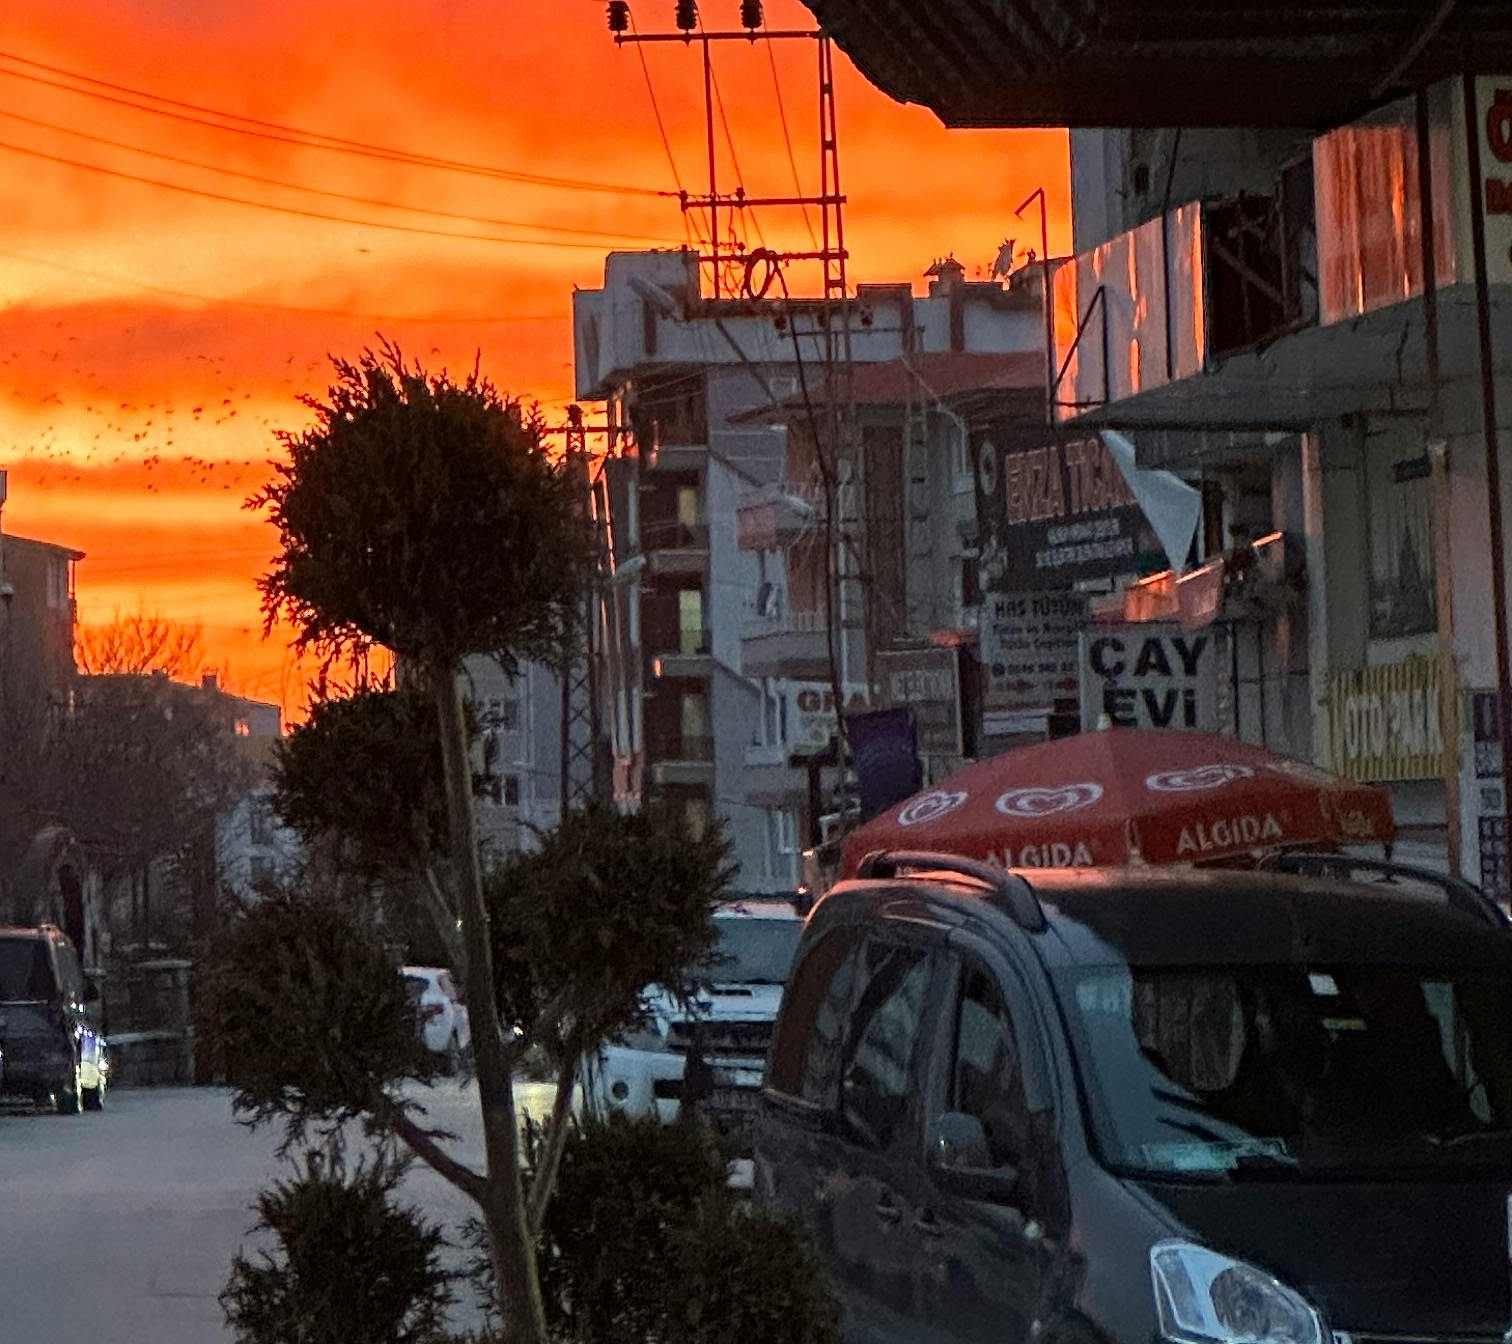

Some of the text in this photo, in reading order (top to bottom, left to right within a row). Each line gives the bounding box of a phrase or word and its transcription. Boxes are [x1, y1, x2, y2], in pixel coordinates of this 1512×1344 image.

[1090, 636, 1209, 687] ÇAY
[1345, 693, 1384, 760] OTO
[1176, 814, 1284, 854] ALGIDA
